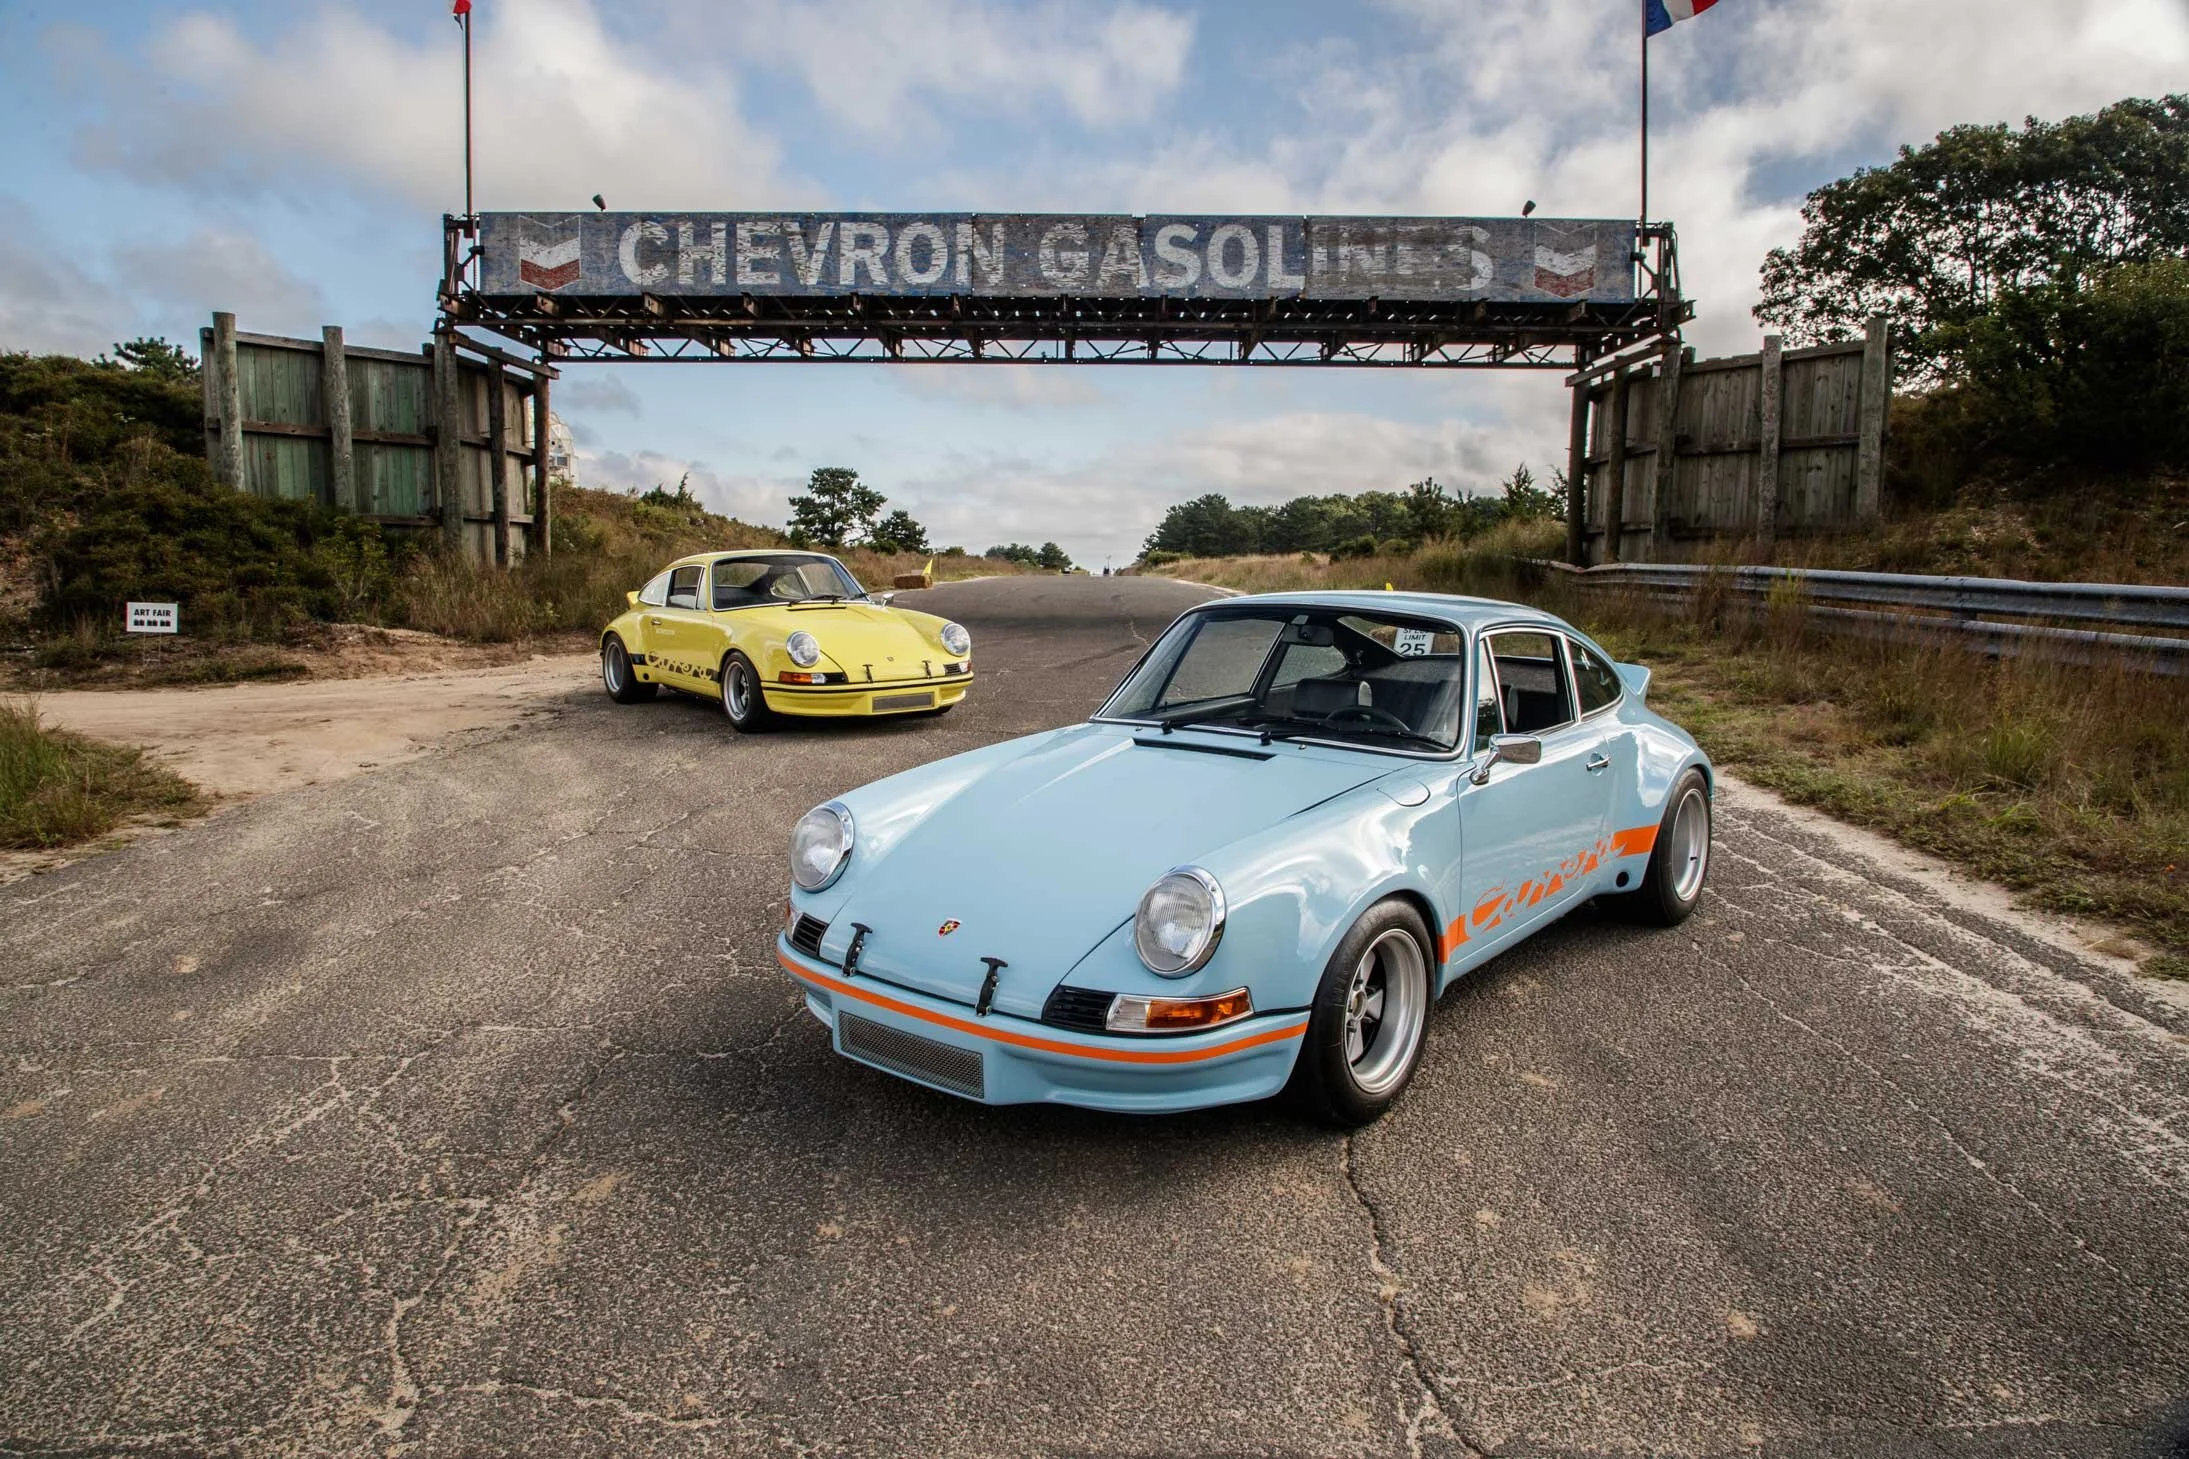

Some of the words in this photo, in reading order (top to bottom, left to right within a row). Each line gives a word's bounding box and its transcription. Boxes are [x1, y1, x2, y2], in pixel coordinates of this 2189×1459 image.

[619, 220, 1004, 287] CHEVRON
[152, 609, 171, 617] FAIR
[1400, 643, 1425, 656] 25
[644, 650, 713, 681] Carrera
[1463, 833, 1628, 938] Carrera
